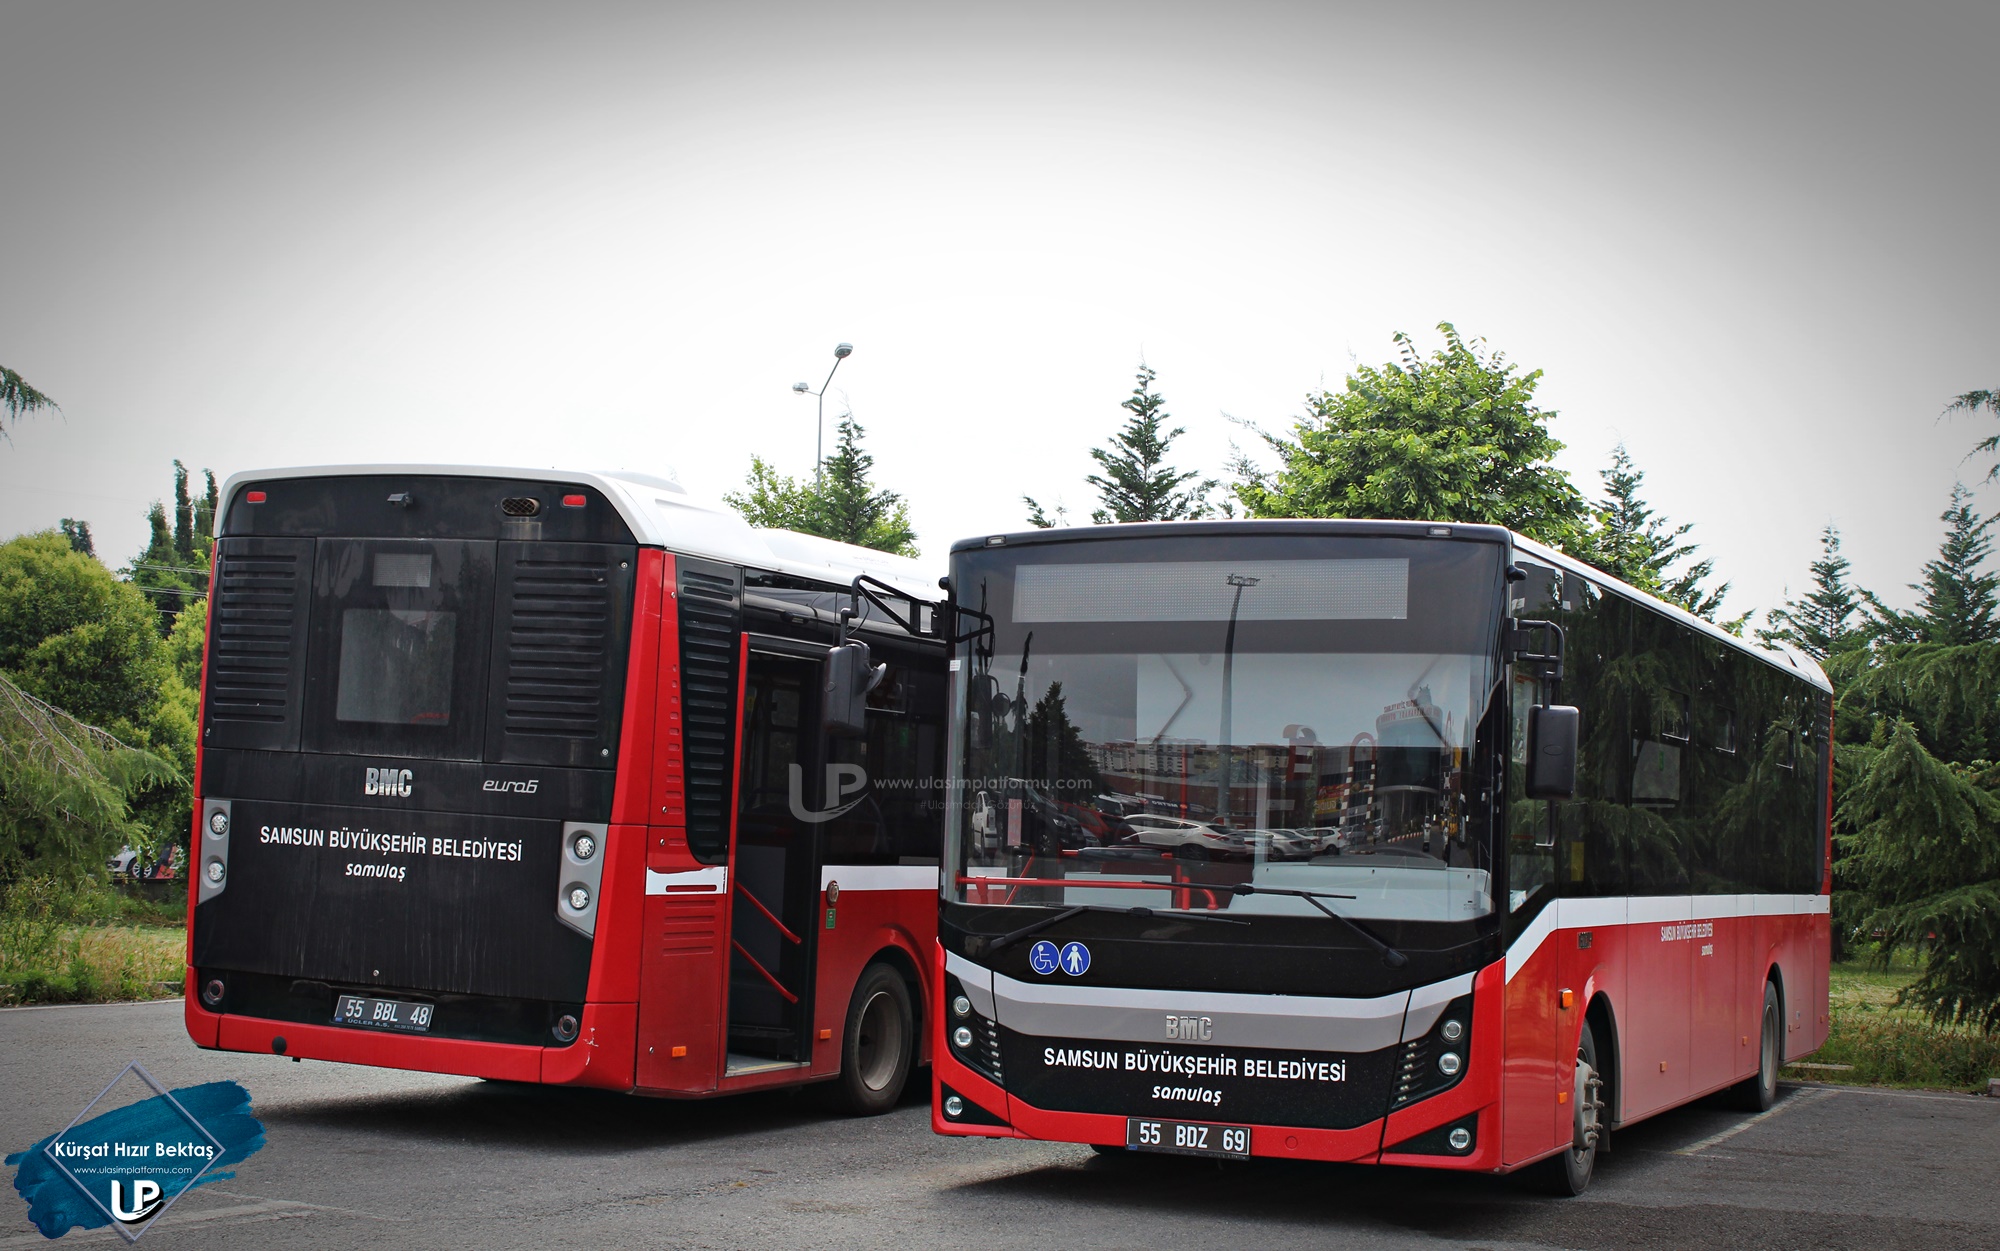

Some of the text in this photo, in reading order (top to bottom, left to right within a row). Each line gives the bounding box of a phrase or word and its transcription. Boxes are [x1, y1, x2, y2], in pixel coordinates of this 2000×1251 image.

[365, 767, 413, 797] BMC
[482, 779, 539, 794] euro6
[260, 825, 522, 862] SAMSUN BÜYÜKŞEHİR BELEDİYESİ
[345, 863, 406, 882] samulaş
[345, 999, 429, 1025] 55 BBL 48
[1165, 1015, 1213, 1041] BMC
[1043, 1047, 1346, 1082] SAMSUN BÜYÜKŞEHİR BELEDİYESİ
[1151, 1085, 1222, 1106] samulaş
[1139, 1122, 1245, 1152] 55 BDZ 69
